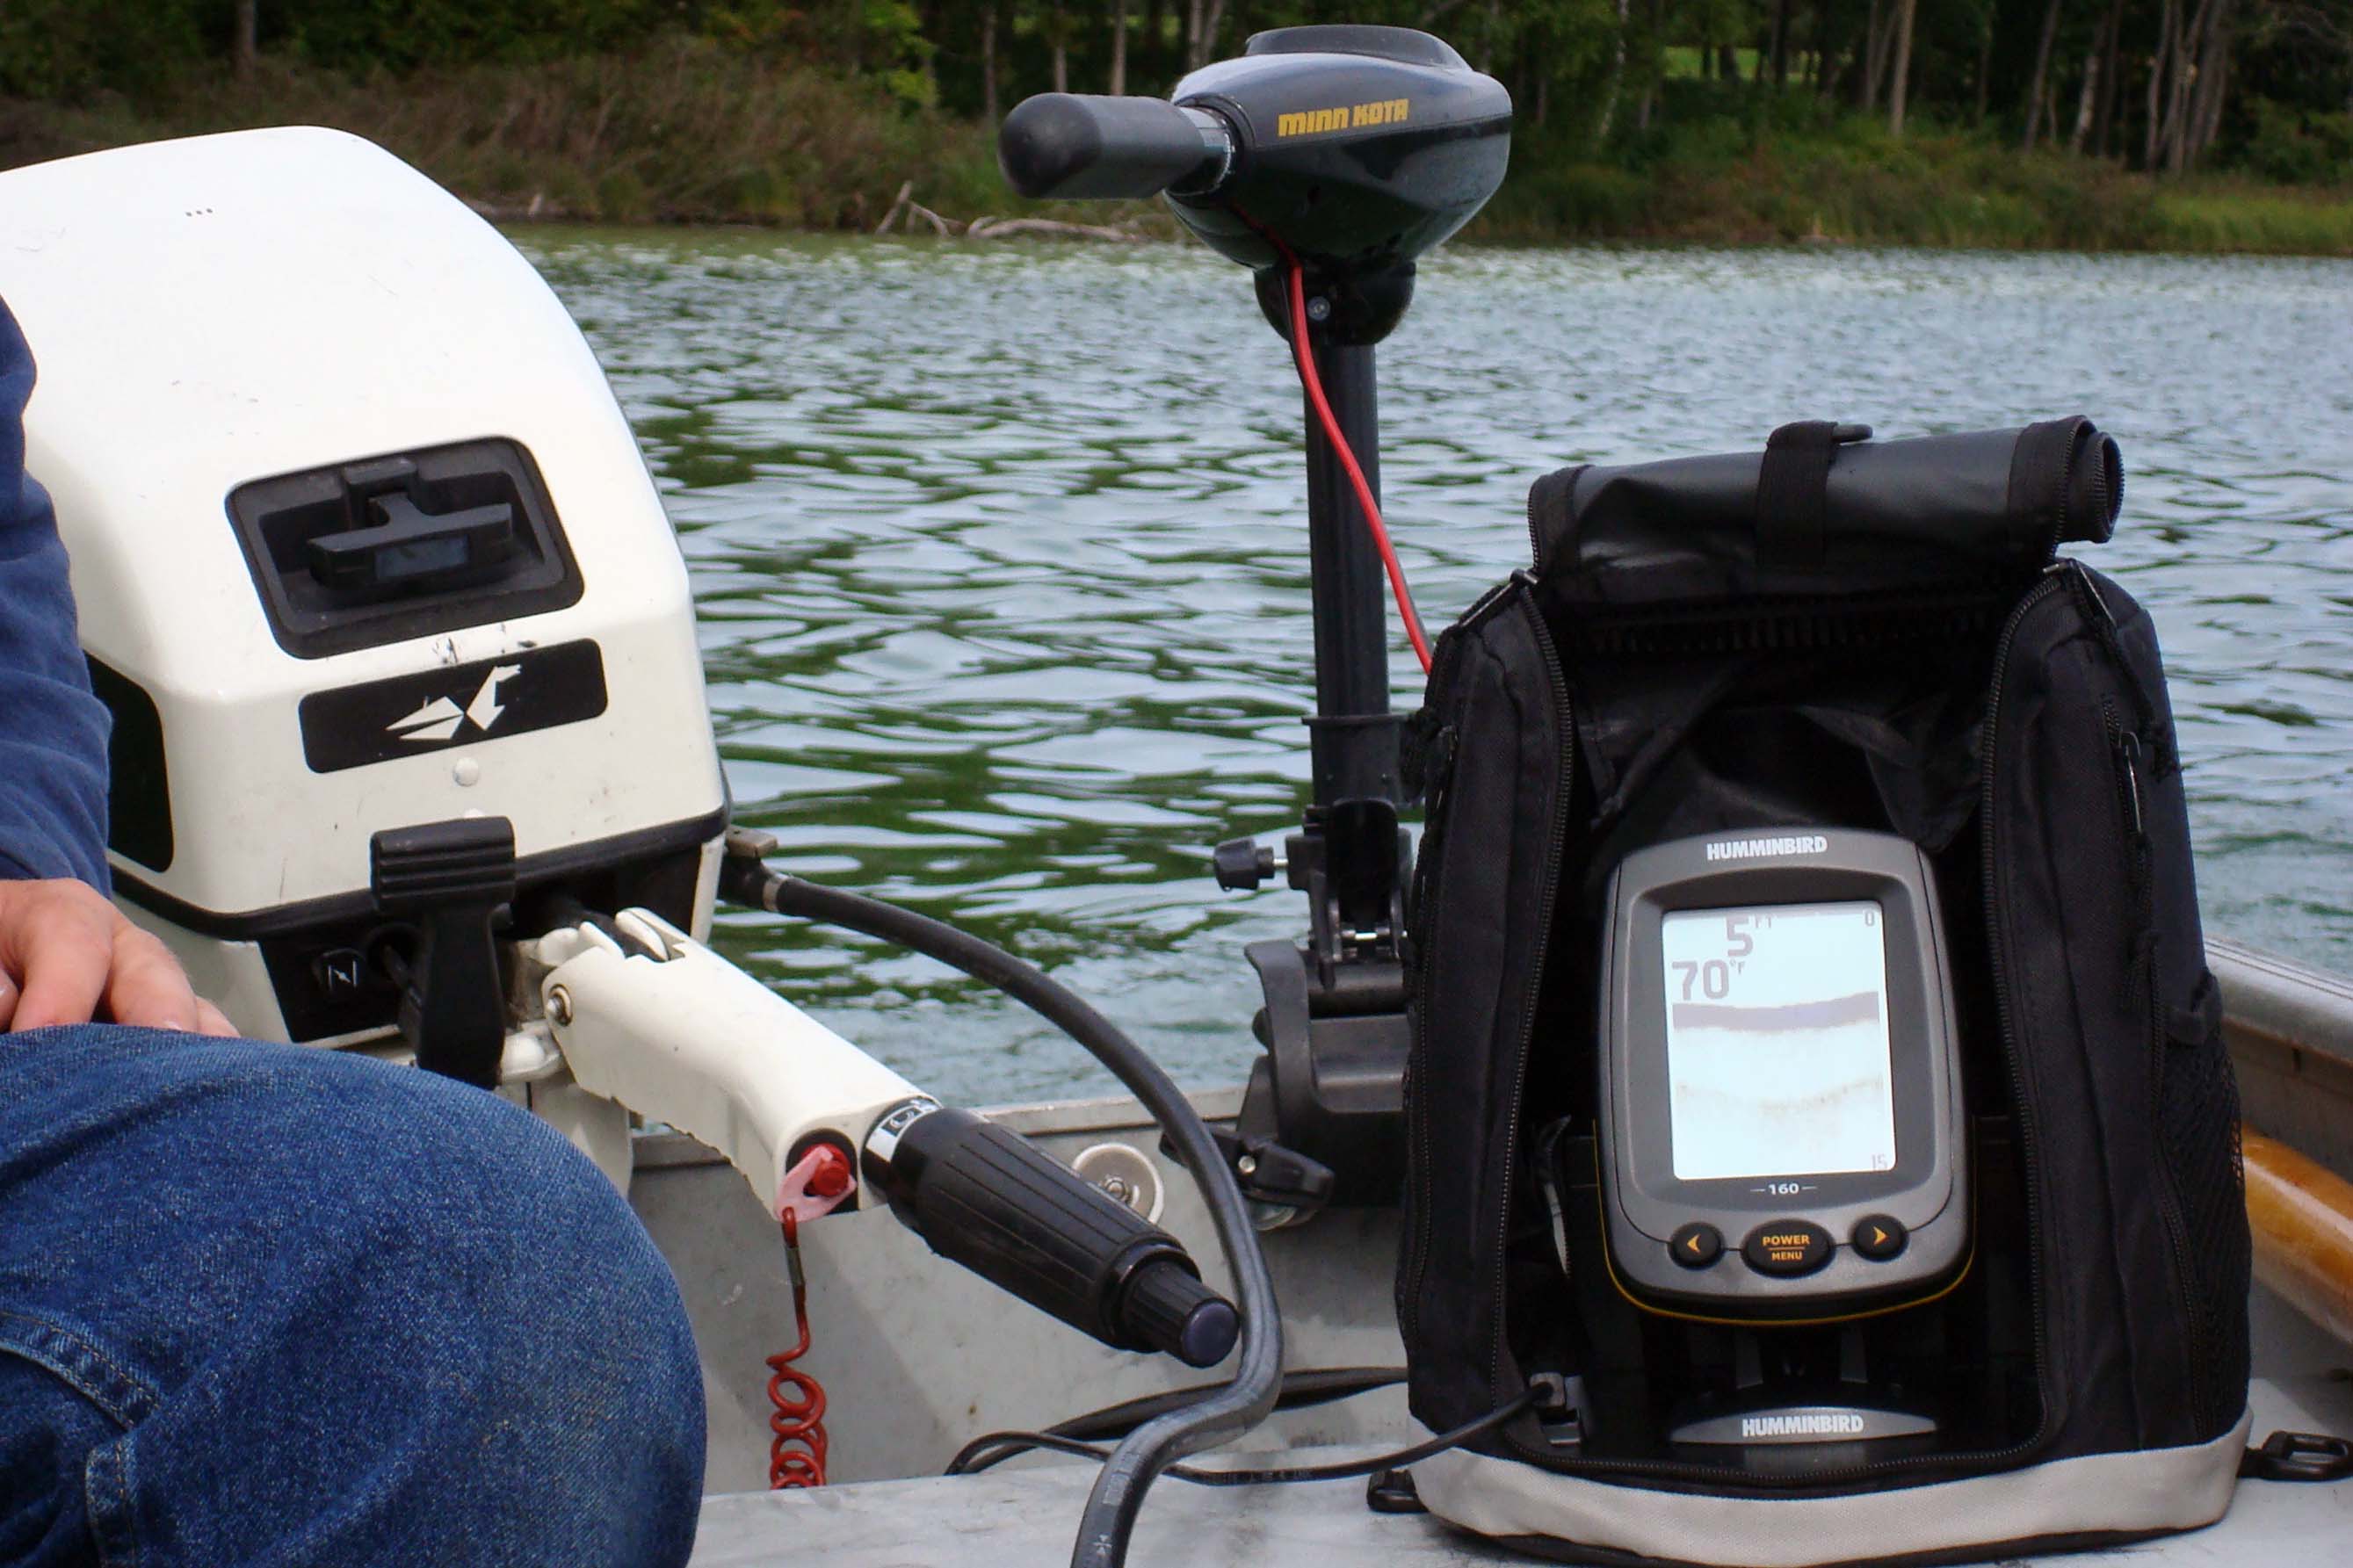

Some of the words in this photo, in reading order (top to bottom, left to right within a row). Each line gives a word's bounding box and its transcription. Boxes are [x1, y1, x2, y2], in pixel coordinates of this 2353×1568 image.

[1351, 98, 1409, 127] KOTA
[1705, 835, 1828, 861] HUMMINBIRD
[1725, 913, 1754, 957] 5
[1768, 1182, 1800, 1196] 160
[1762, 1234, 1811, 1247] POWER
[1770, 1251, 1804, 1261] MENU
[1741, 1414, 1864, 1437] HUMMINBIRD
